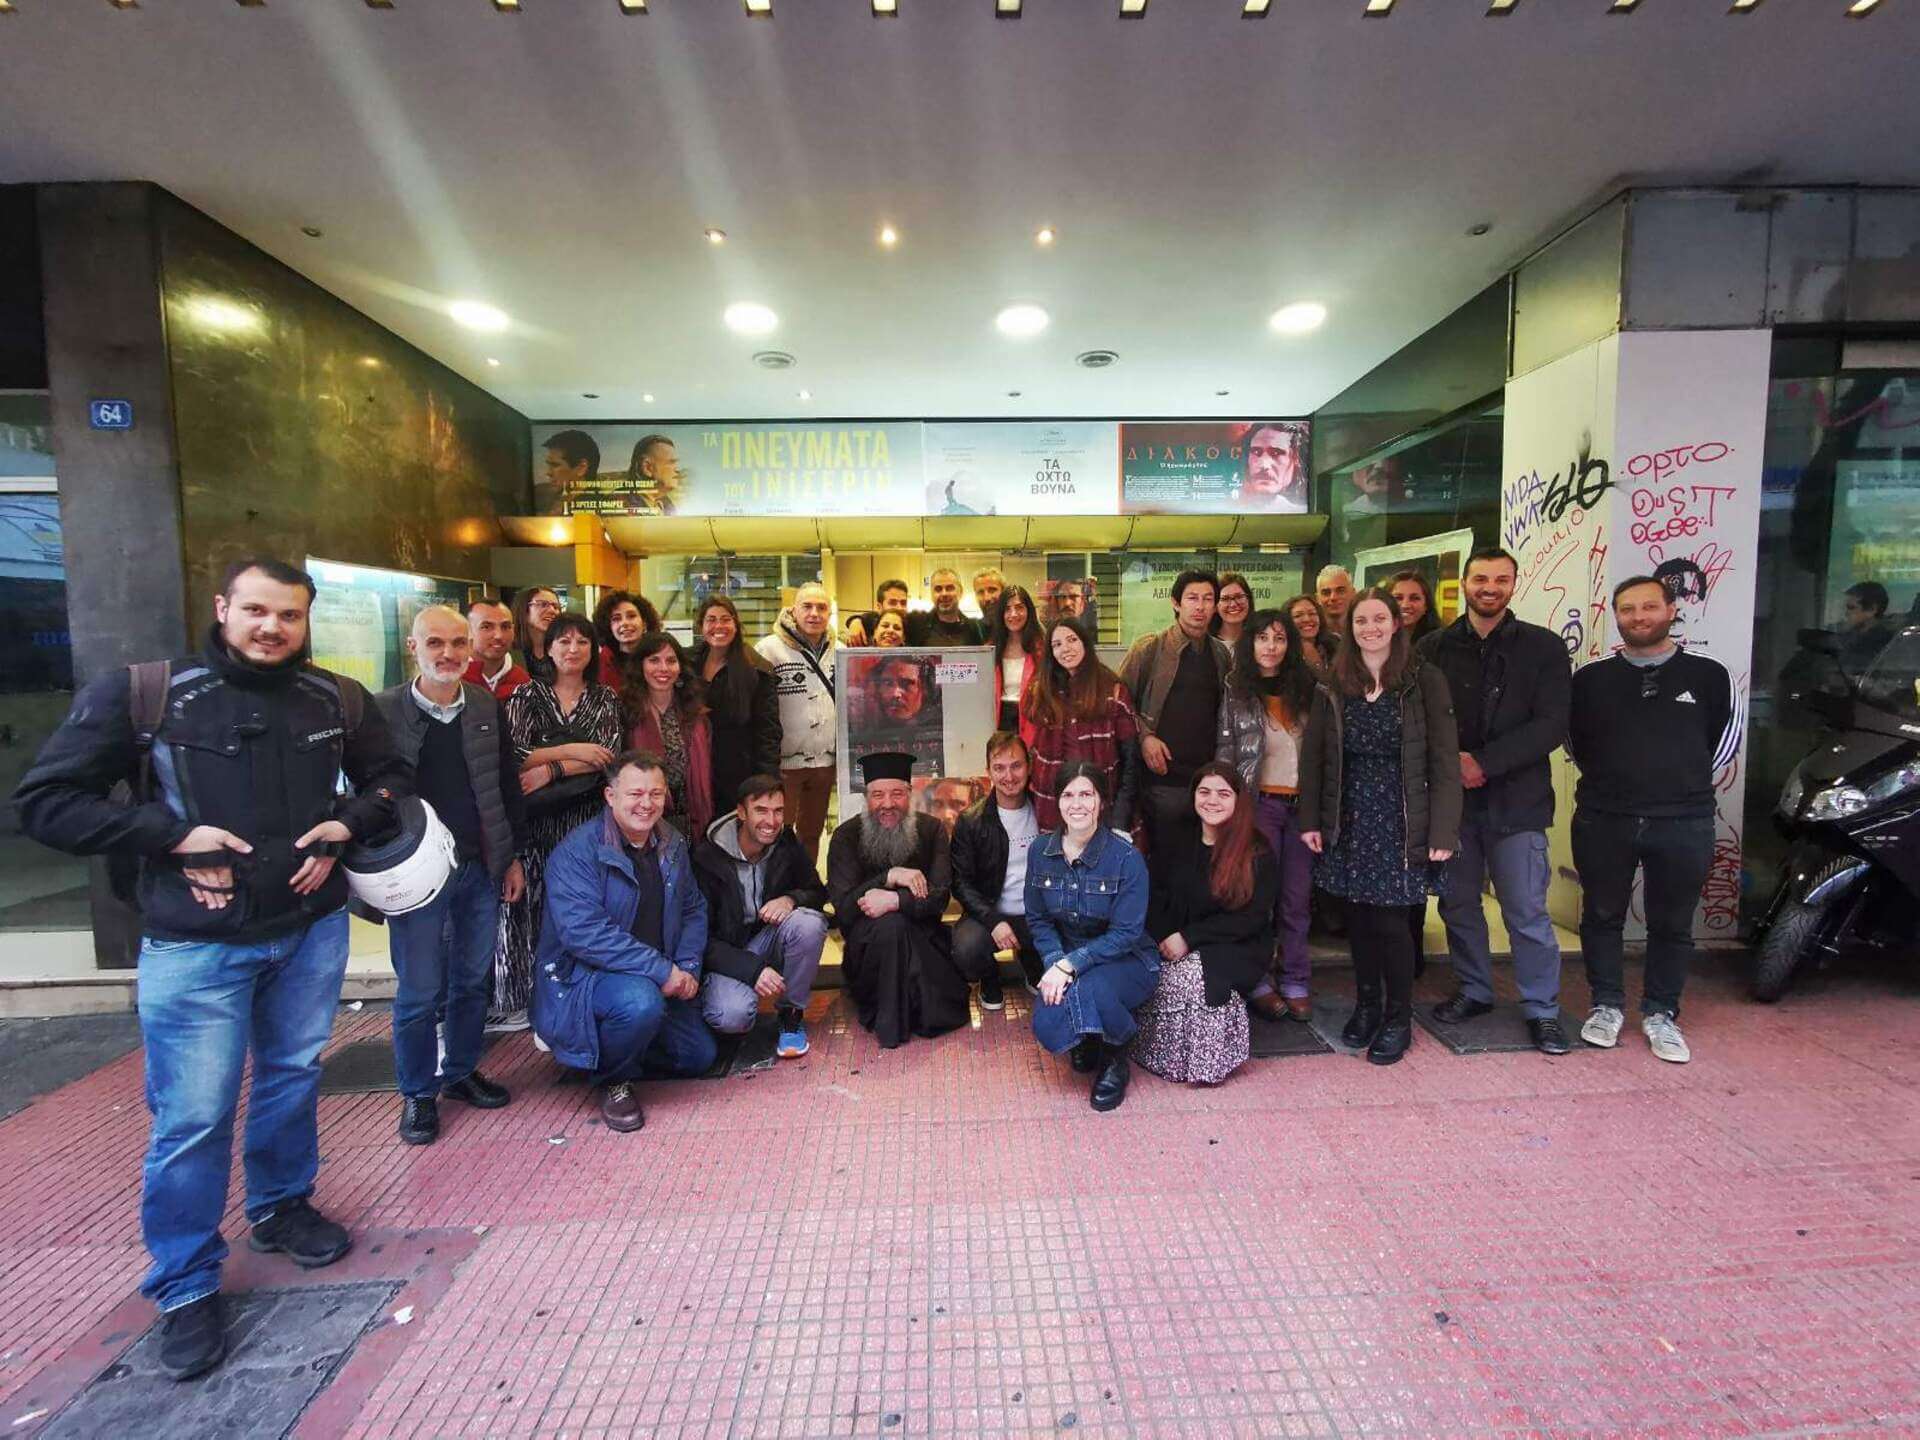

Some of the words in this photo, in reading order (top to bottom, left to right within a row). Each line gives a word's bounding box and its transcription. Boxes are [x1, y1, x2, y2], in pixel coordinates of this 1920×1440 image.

[100, 403, 122, 423] 64
[721, 430, 892, 470] ΠΝΕΥΜΑΤΑ
[1043, 458, 1060, 469] ΤΑ
[1036, 471, 1071, 482] ΟΧΤΩ
[1031, 484, 1076, 494] ΒΟΥΝΑ
